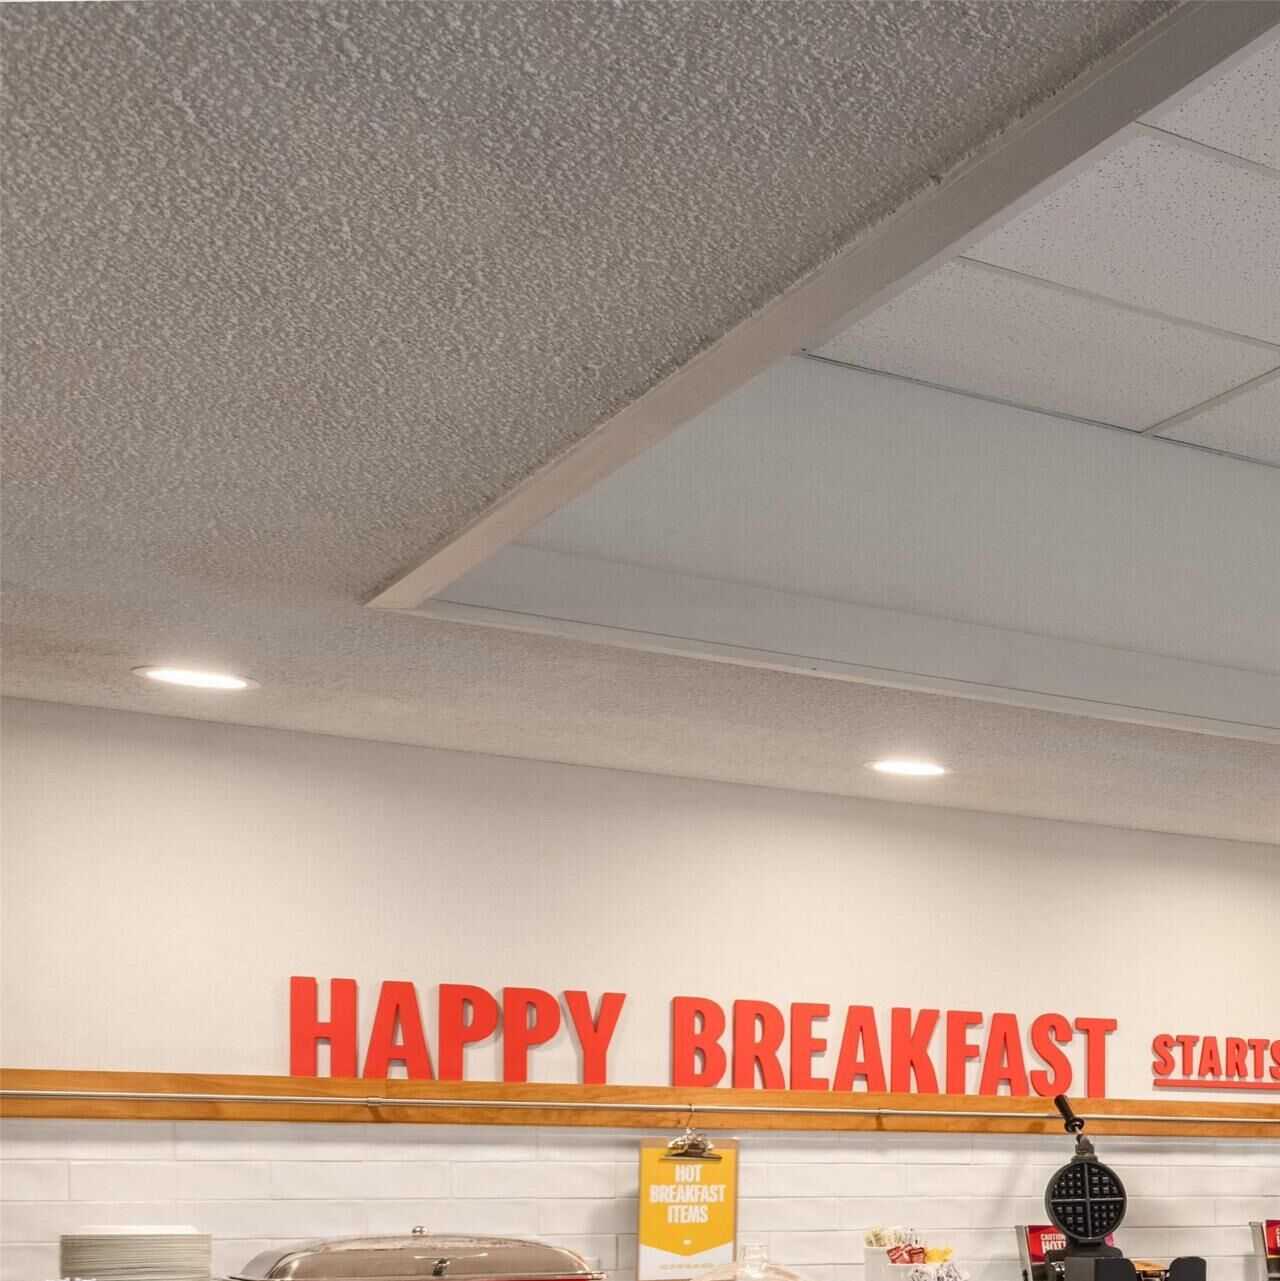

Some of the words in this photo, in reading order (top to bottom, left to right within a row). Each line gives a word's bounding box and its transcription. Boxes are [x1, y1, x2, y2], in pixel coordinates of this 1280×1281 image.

[290, 976, 627, 1085] HAPPY
[671, 996, 1118, 1099] BREAKFAST
[675, 1164, 703, 1183] HOT
[649, 1184, 727, 1203] BREAKFAST
[667, 1205, 709, 1224] ITEMS
